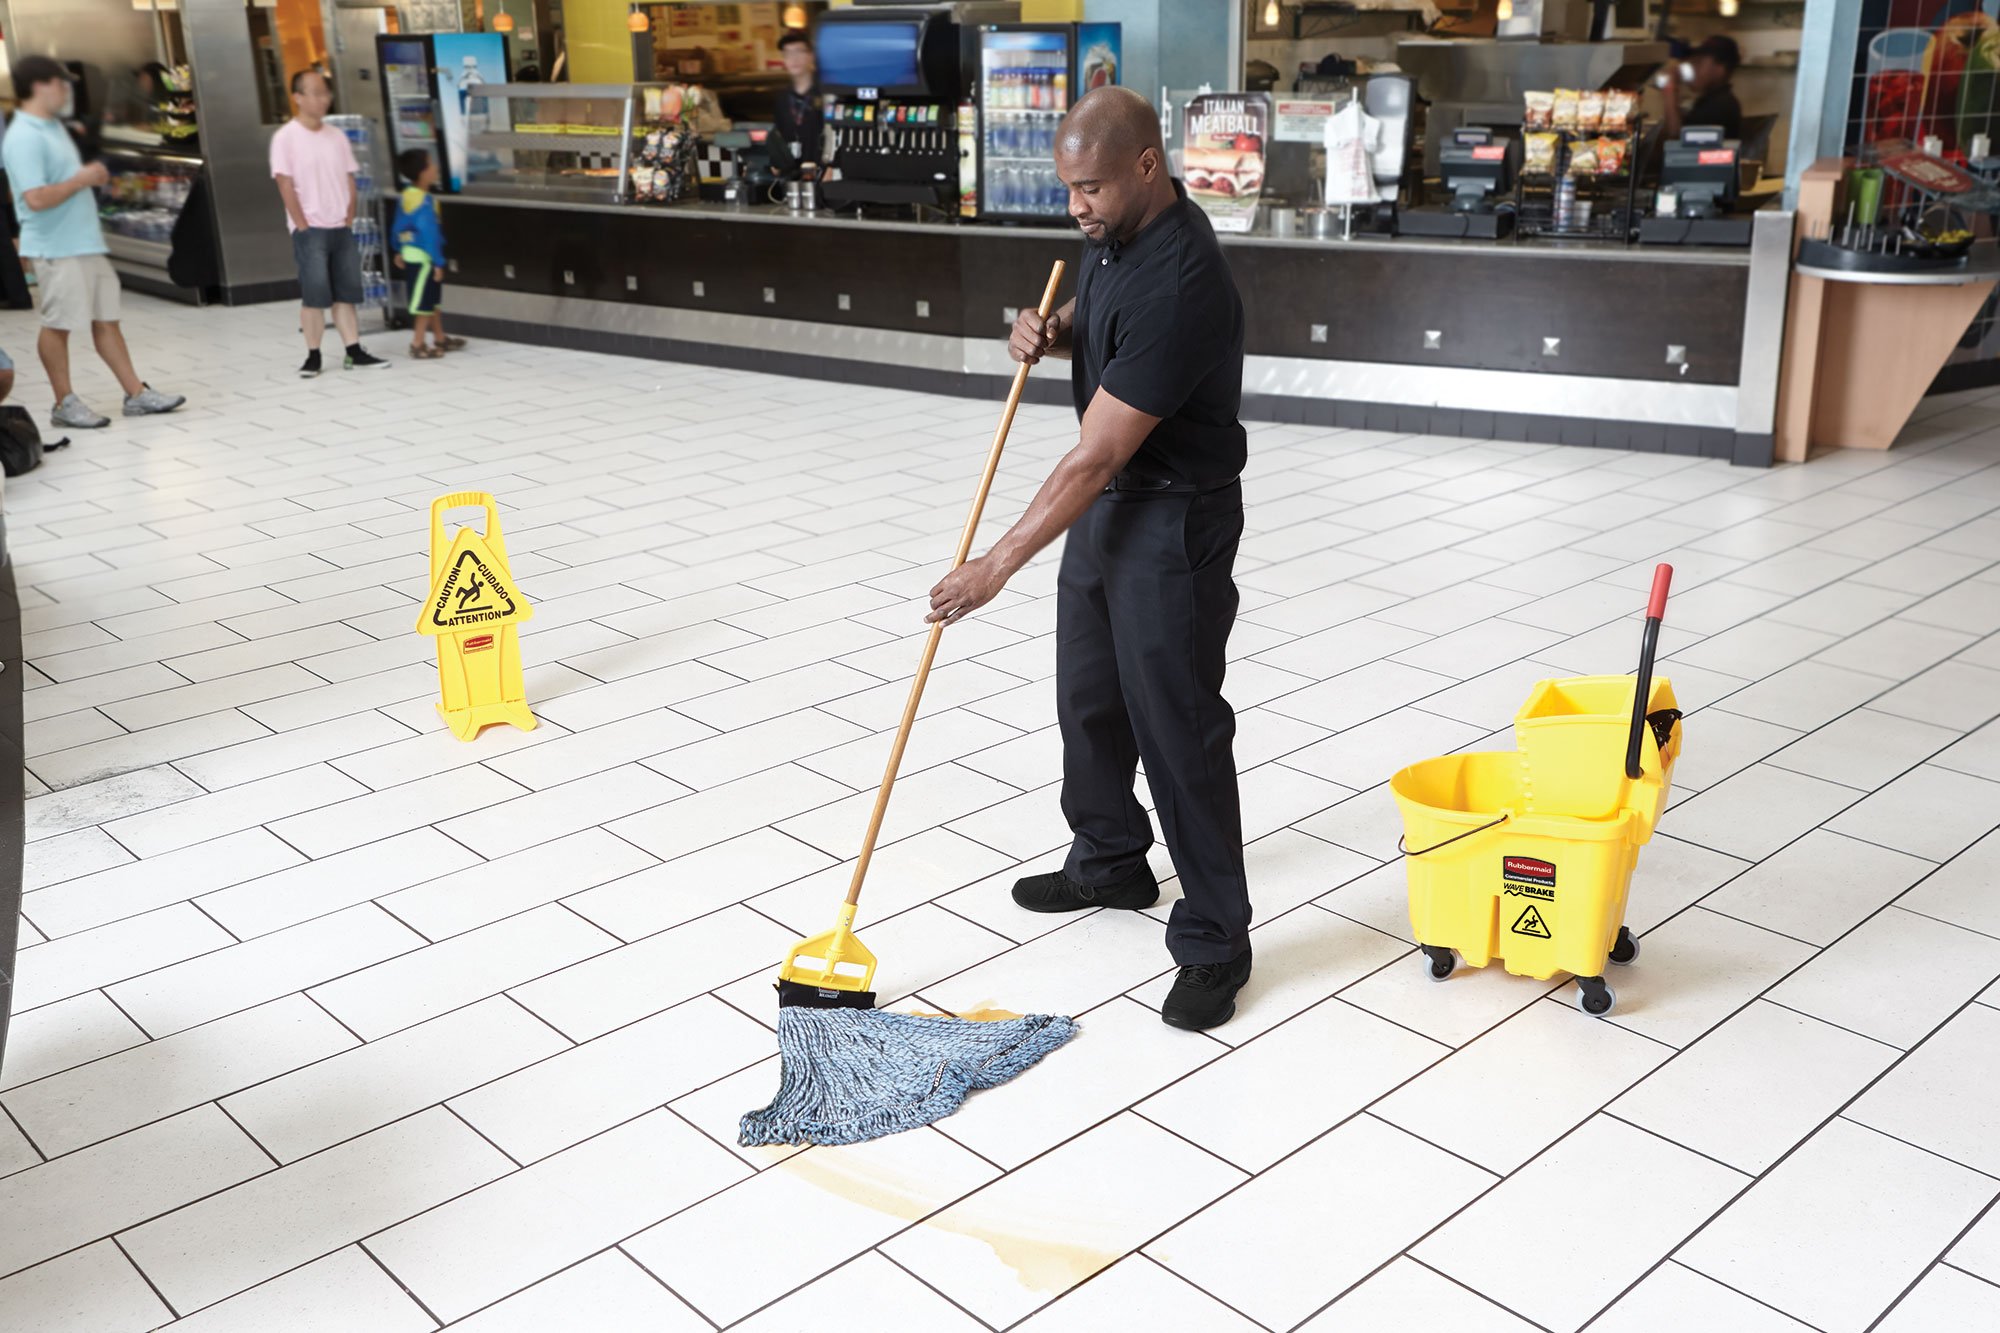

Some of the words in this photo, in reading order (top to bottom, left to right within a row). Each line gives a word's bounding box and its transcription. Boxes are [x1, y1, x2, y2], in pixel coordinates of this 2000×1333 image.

[1203, 99, 1245, 114] ITALIAN
[1191, 114, 1261, 135] MEATBALL
[437, 567, 461, 609] CAUTION
[477, 563, 508, 600] CUIDADO
[448, 610, 501, 626] ATTENTION
[1507, 861, 1552, 874] Rubbermaid
[1504, 873, 1533, 882] Commercial
[1533, 877, 1554, 886] Products
